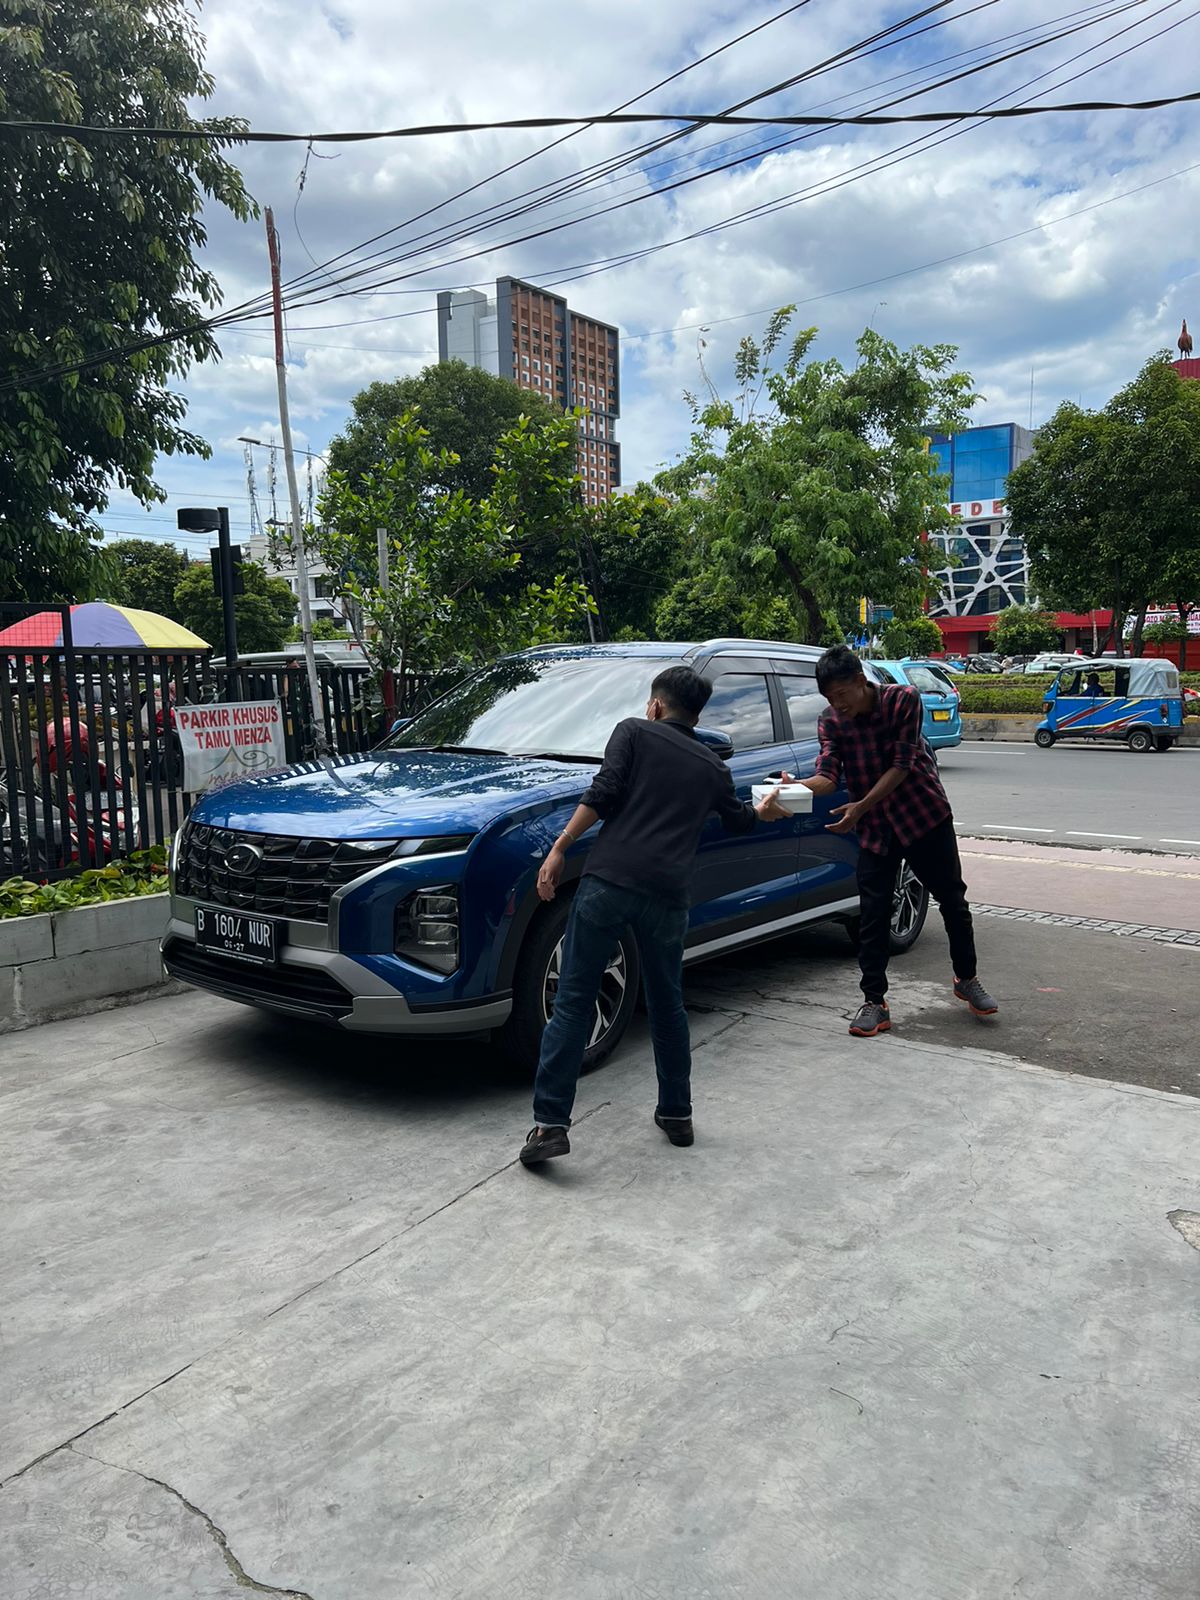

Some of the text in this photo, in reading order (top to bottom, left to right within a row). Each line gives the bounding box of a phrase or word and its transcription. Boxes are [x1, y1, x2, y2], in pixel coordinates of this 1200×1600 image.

[179, 706, 279, 729] PARKIR KHUSUS
[194, 726, 272, 749] TAMU MENZA
[197, 909, 271, 948] B 1604 NUR
